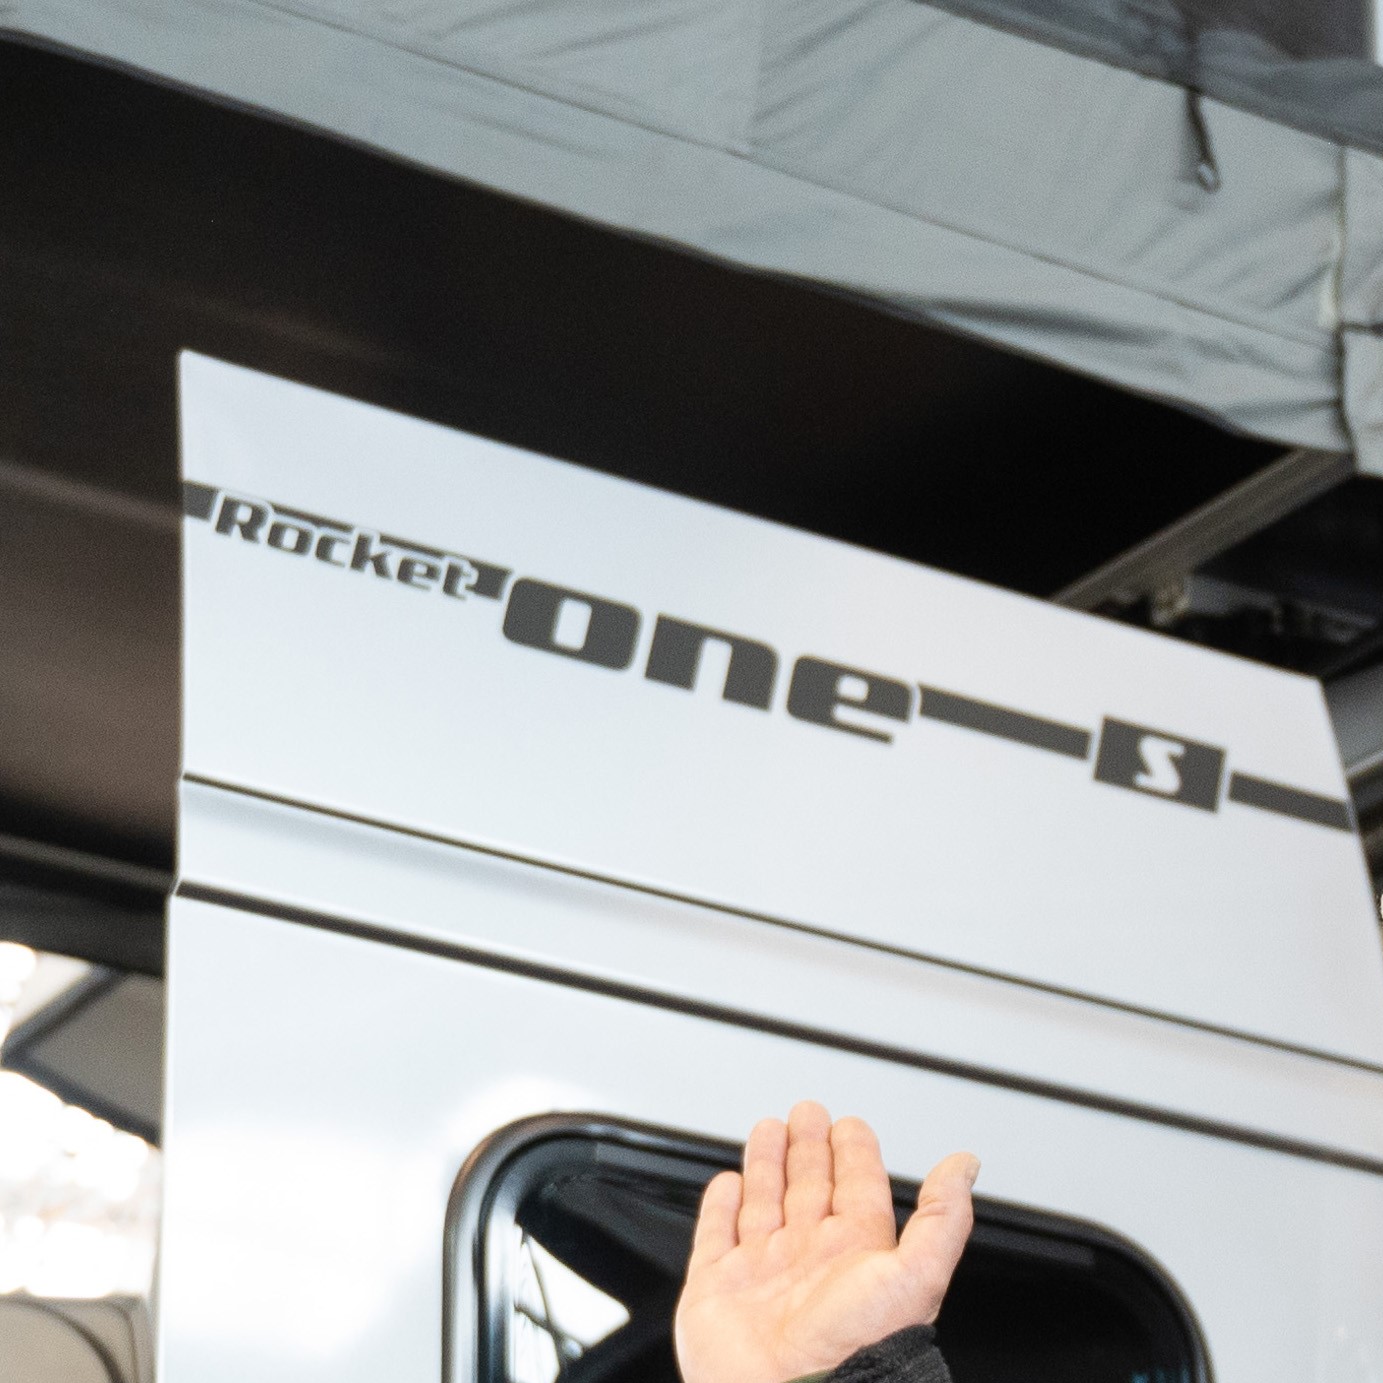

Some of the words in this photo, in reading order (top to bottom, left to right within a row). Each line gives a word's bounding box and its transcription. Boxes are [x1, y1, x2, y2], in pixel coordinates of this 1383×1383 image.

[214, 495, 469, 601] Rocket
[502, 576, 913, 744] one
[1133, 735, 1186, 796] S
